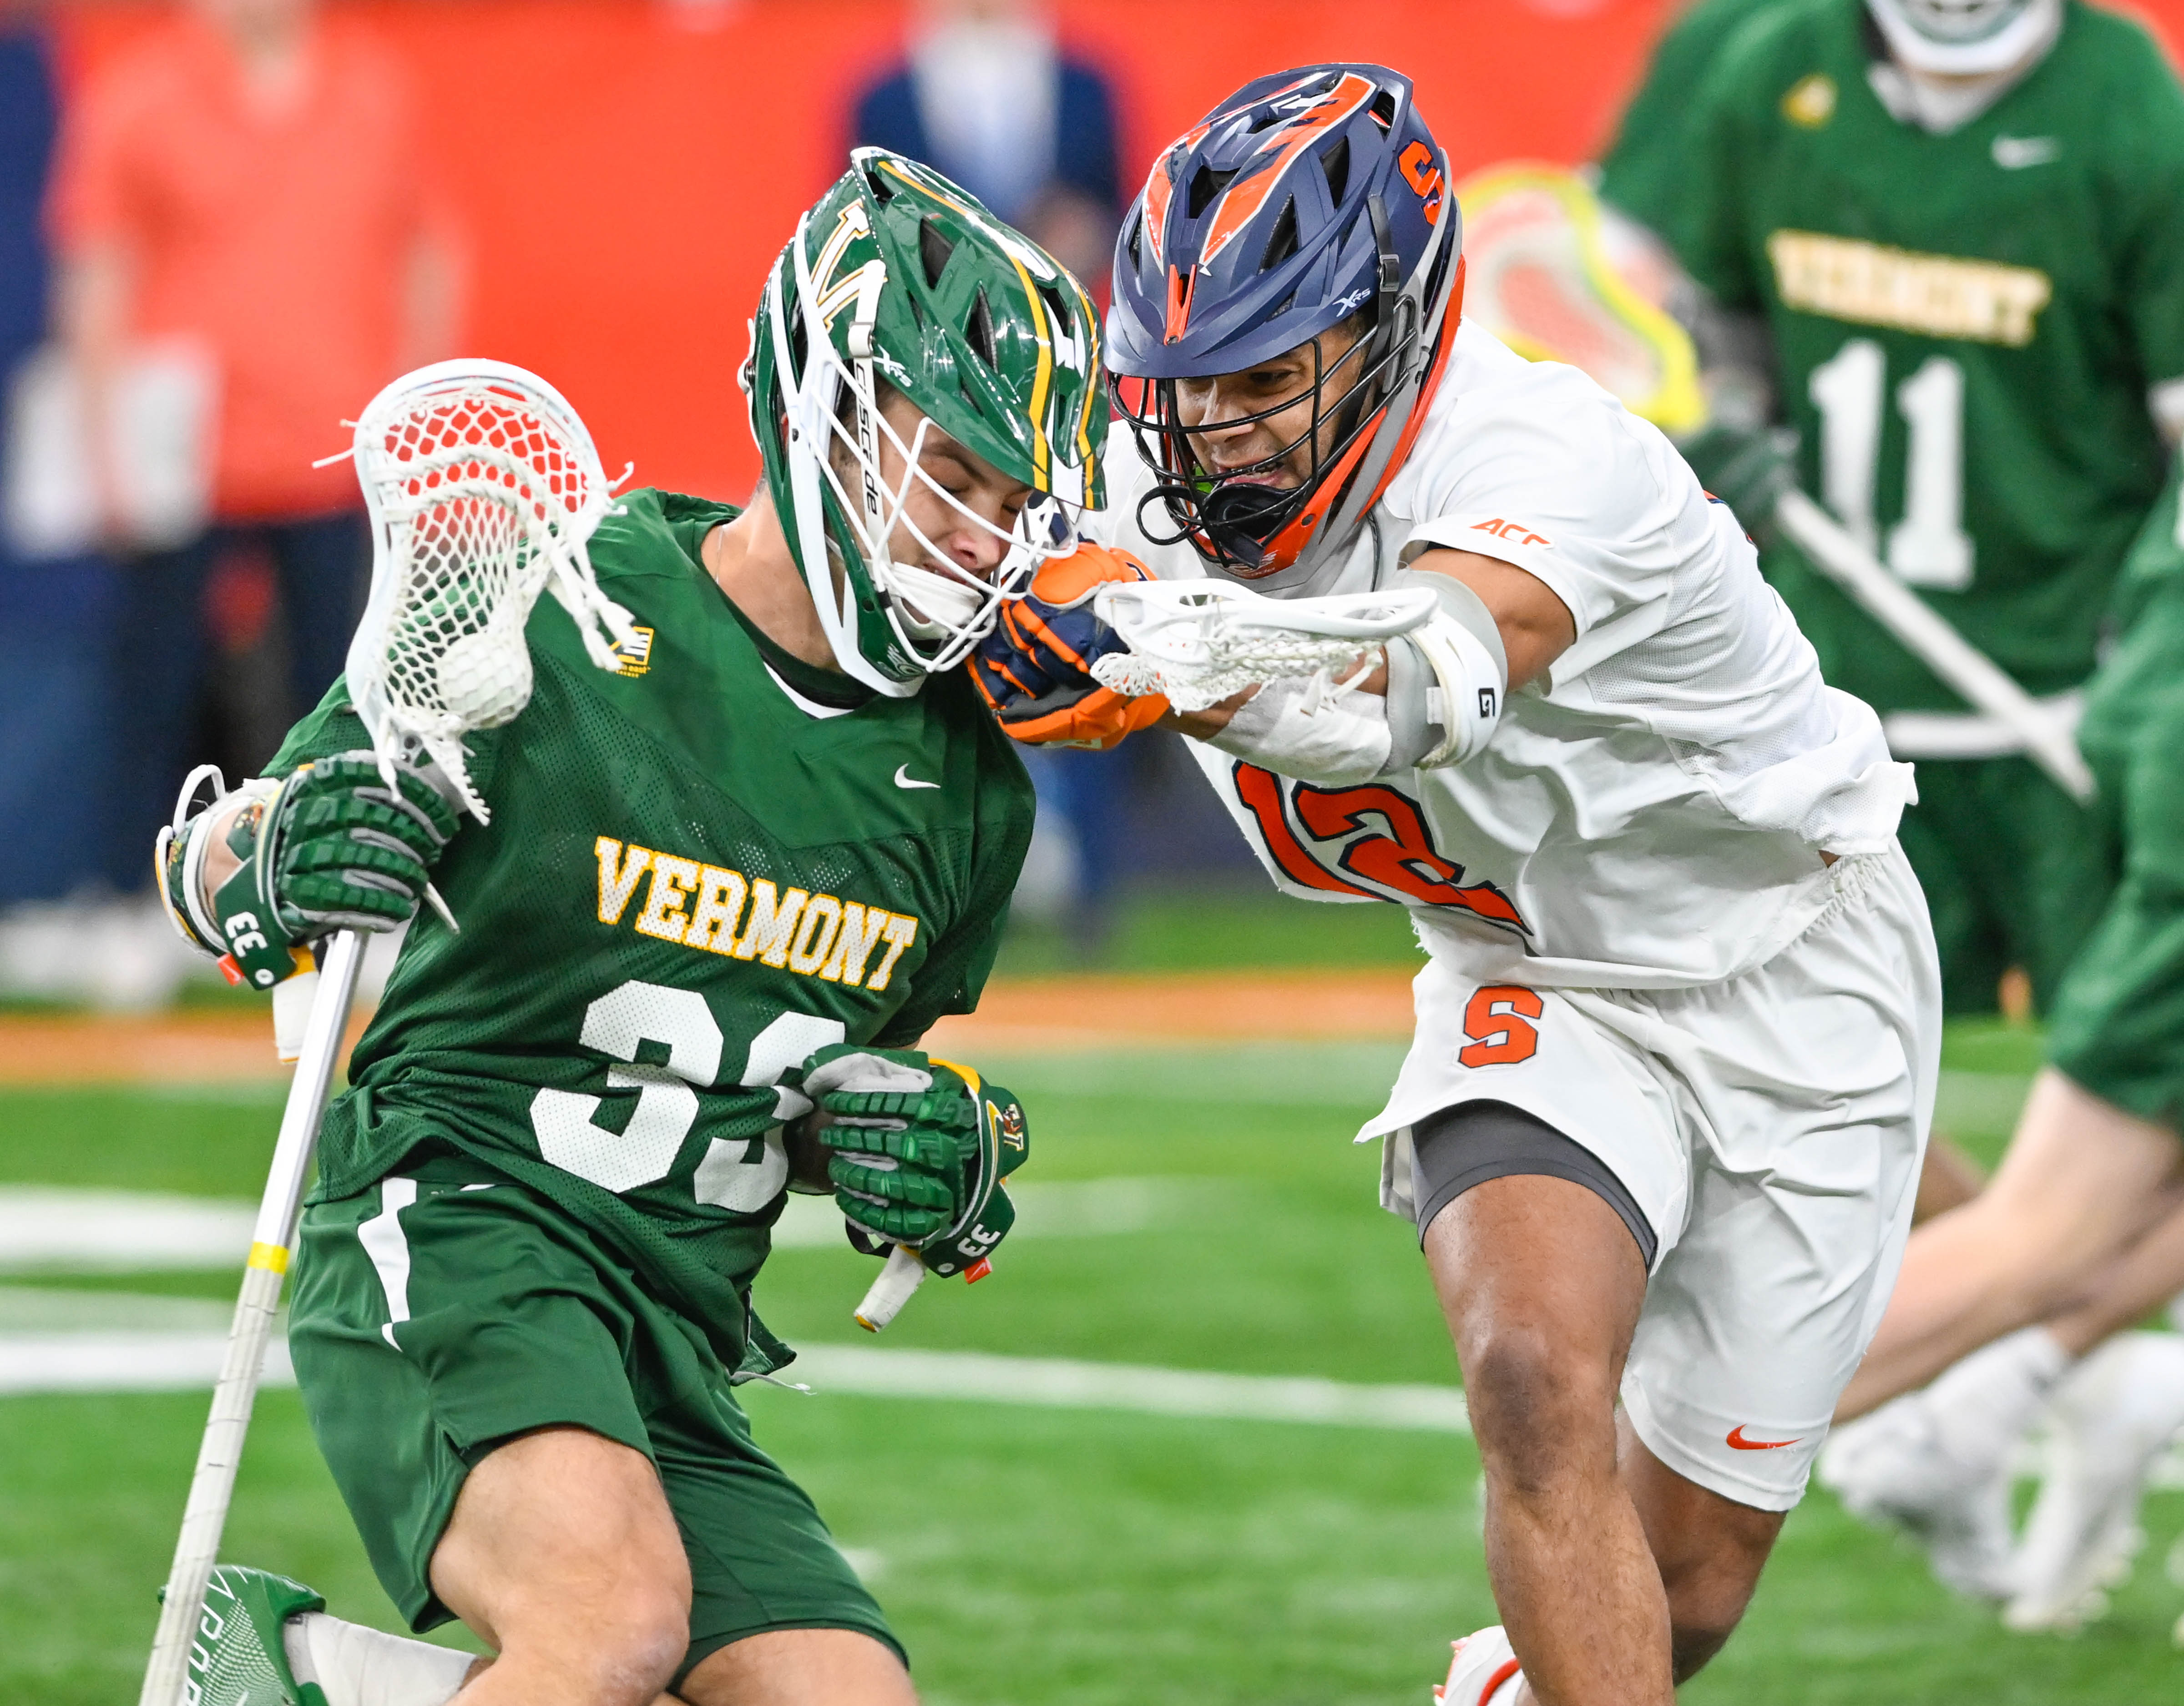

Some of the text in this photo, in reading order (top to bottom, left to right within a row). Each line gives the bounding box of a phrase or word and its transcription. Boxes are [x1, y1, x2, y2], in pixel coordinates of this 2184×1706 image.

[1332, 288, 1370, 317] XRS
[1768, 230, 2050, 347] VERMONT
[1810, 339, 1976, 591] 11
[1232, 759, 1534, 936] 12
[225, 912, 268, 958] 33
[594, 836, 918, 990] VERMONT
[1458, 985, 1544, 1068] S
[957, 1223, 1001, 1257] 33
